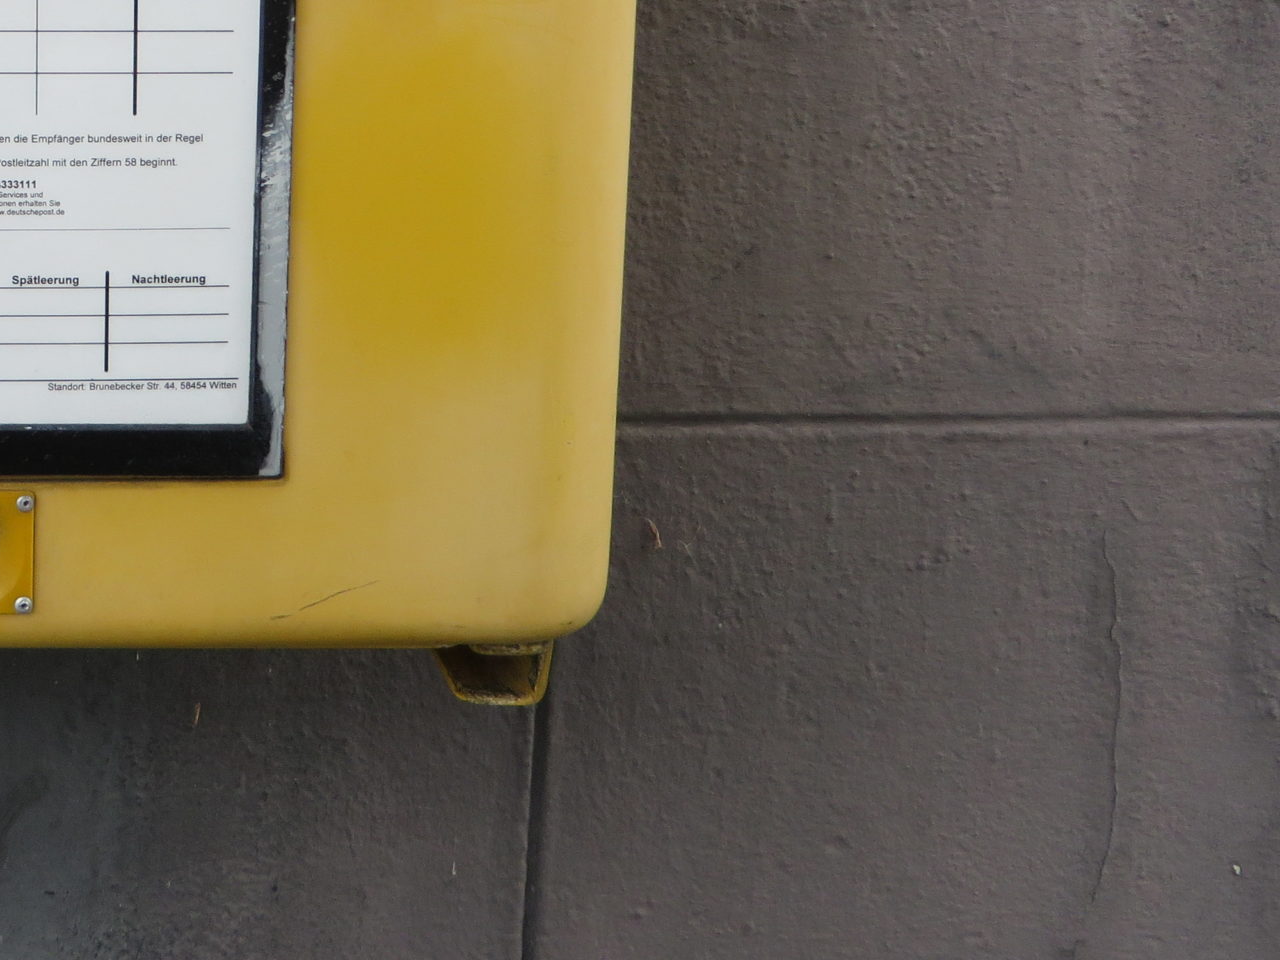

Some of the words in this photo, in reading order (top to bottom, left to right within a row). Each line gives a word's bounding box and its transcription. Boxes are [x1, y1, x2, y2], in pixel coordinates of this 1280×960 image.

[13, 134, 28, 143] die
[31, 134, 84, 145] Empfänger
[88, 134, 142, 143] bundesweit
[145, 134, 153, 143] in
[156, 134, 172, 143] der
[175, 134, 203, 144] Regel
[52, 158, 67, 167] mit
[70, 158, 88, 167] den
[91, 158, 122, 167] Ziffern
[125, 158, 137, 167] 58
[140, 158, 177, 168] beginnt.
[12, 275, 79, 286] Spätleerung
[132, 275, 206, 285] Nachtleerung
[164, 382, 177, 390] 44,
